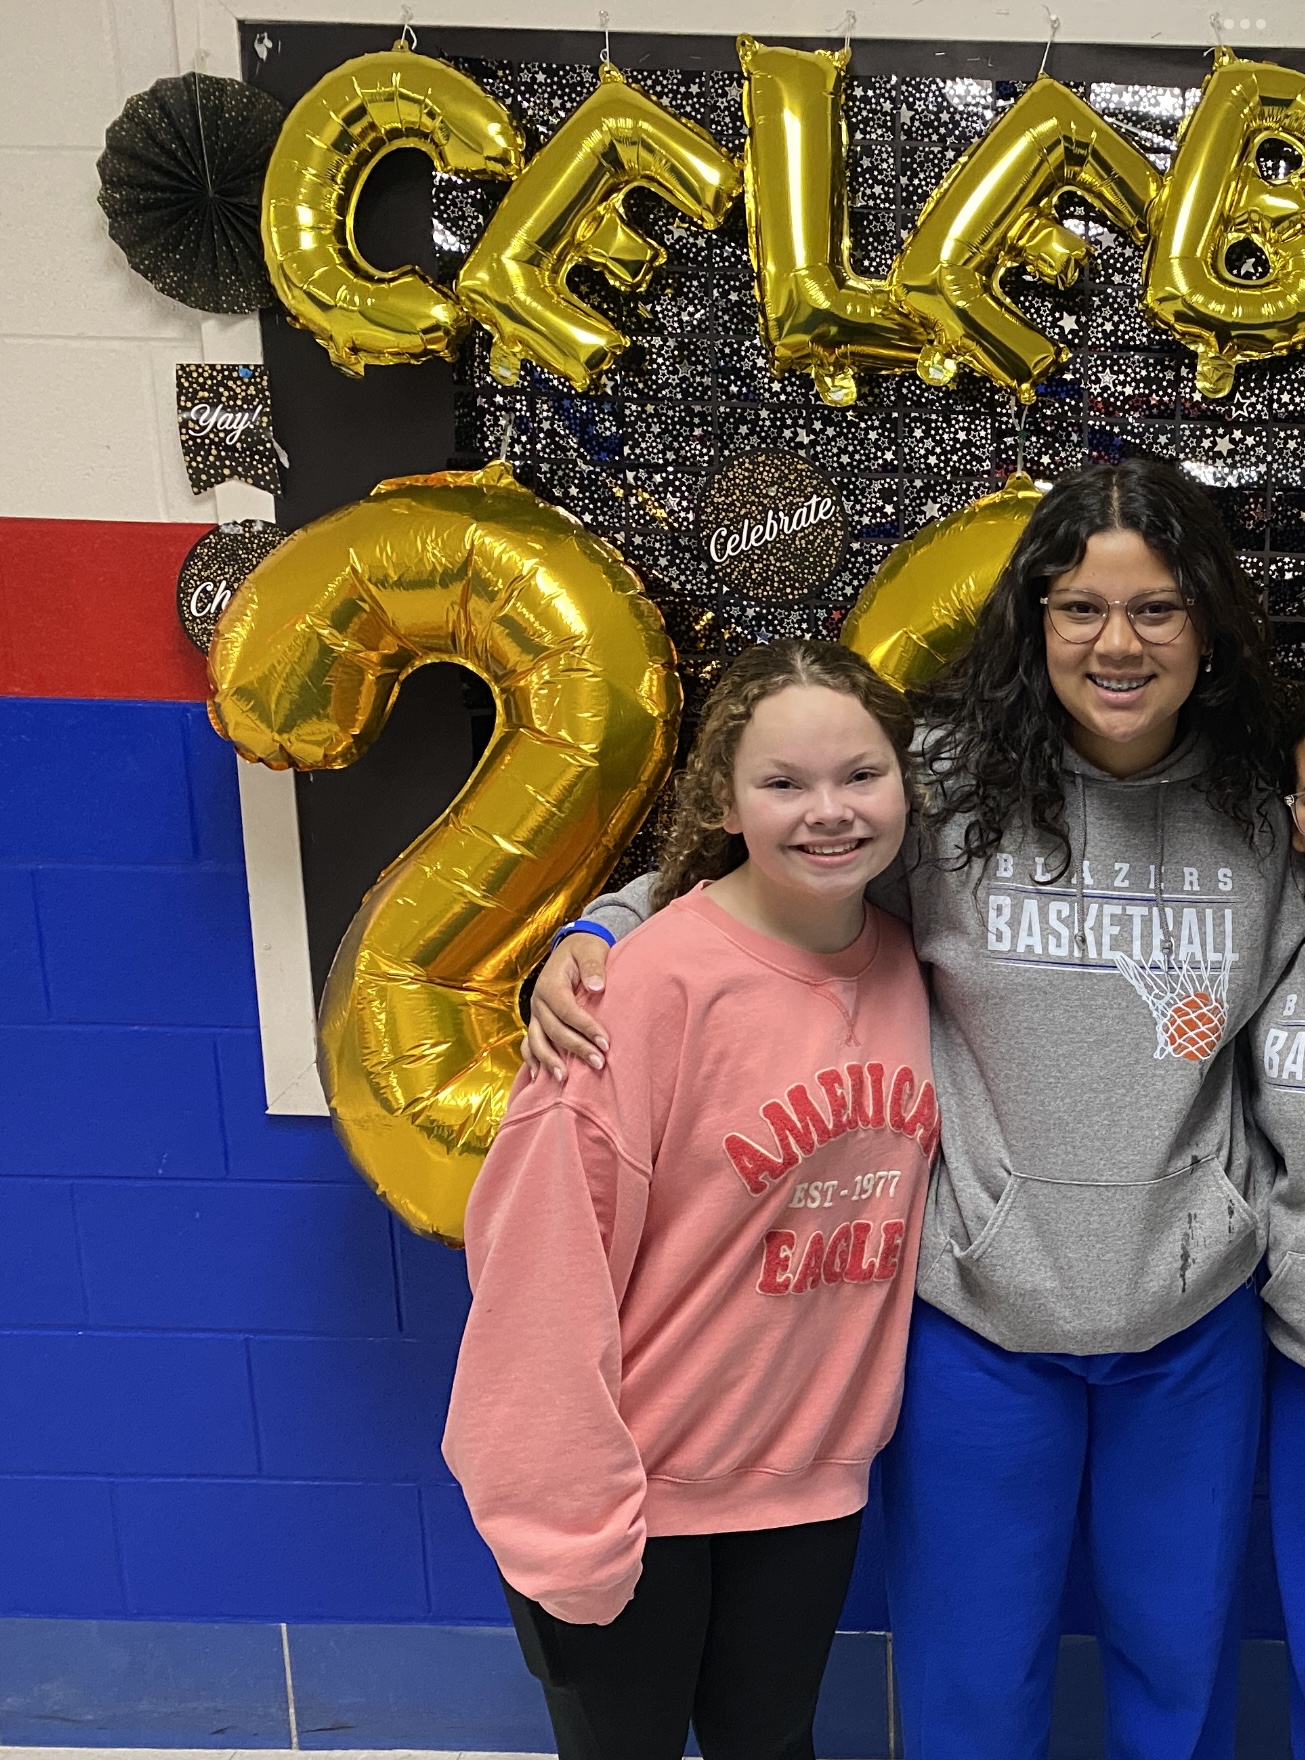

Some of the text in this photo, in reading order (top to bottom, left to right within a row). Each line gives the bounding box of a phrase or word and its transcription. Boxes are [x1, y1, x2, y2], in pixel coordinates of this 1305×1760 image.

[187, 403, 263, 446] Yay!
[709, 494, 836, 563] Celebrate
[986, 894, 1240, 962] BASKETBALL
[755, 1218, 905, 1296] EAGLE
